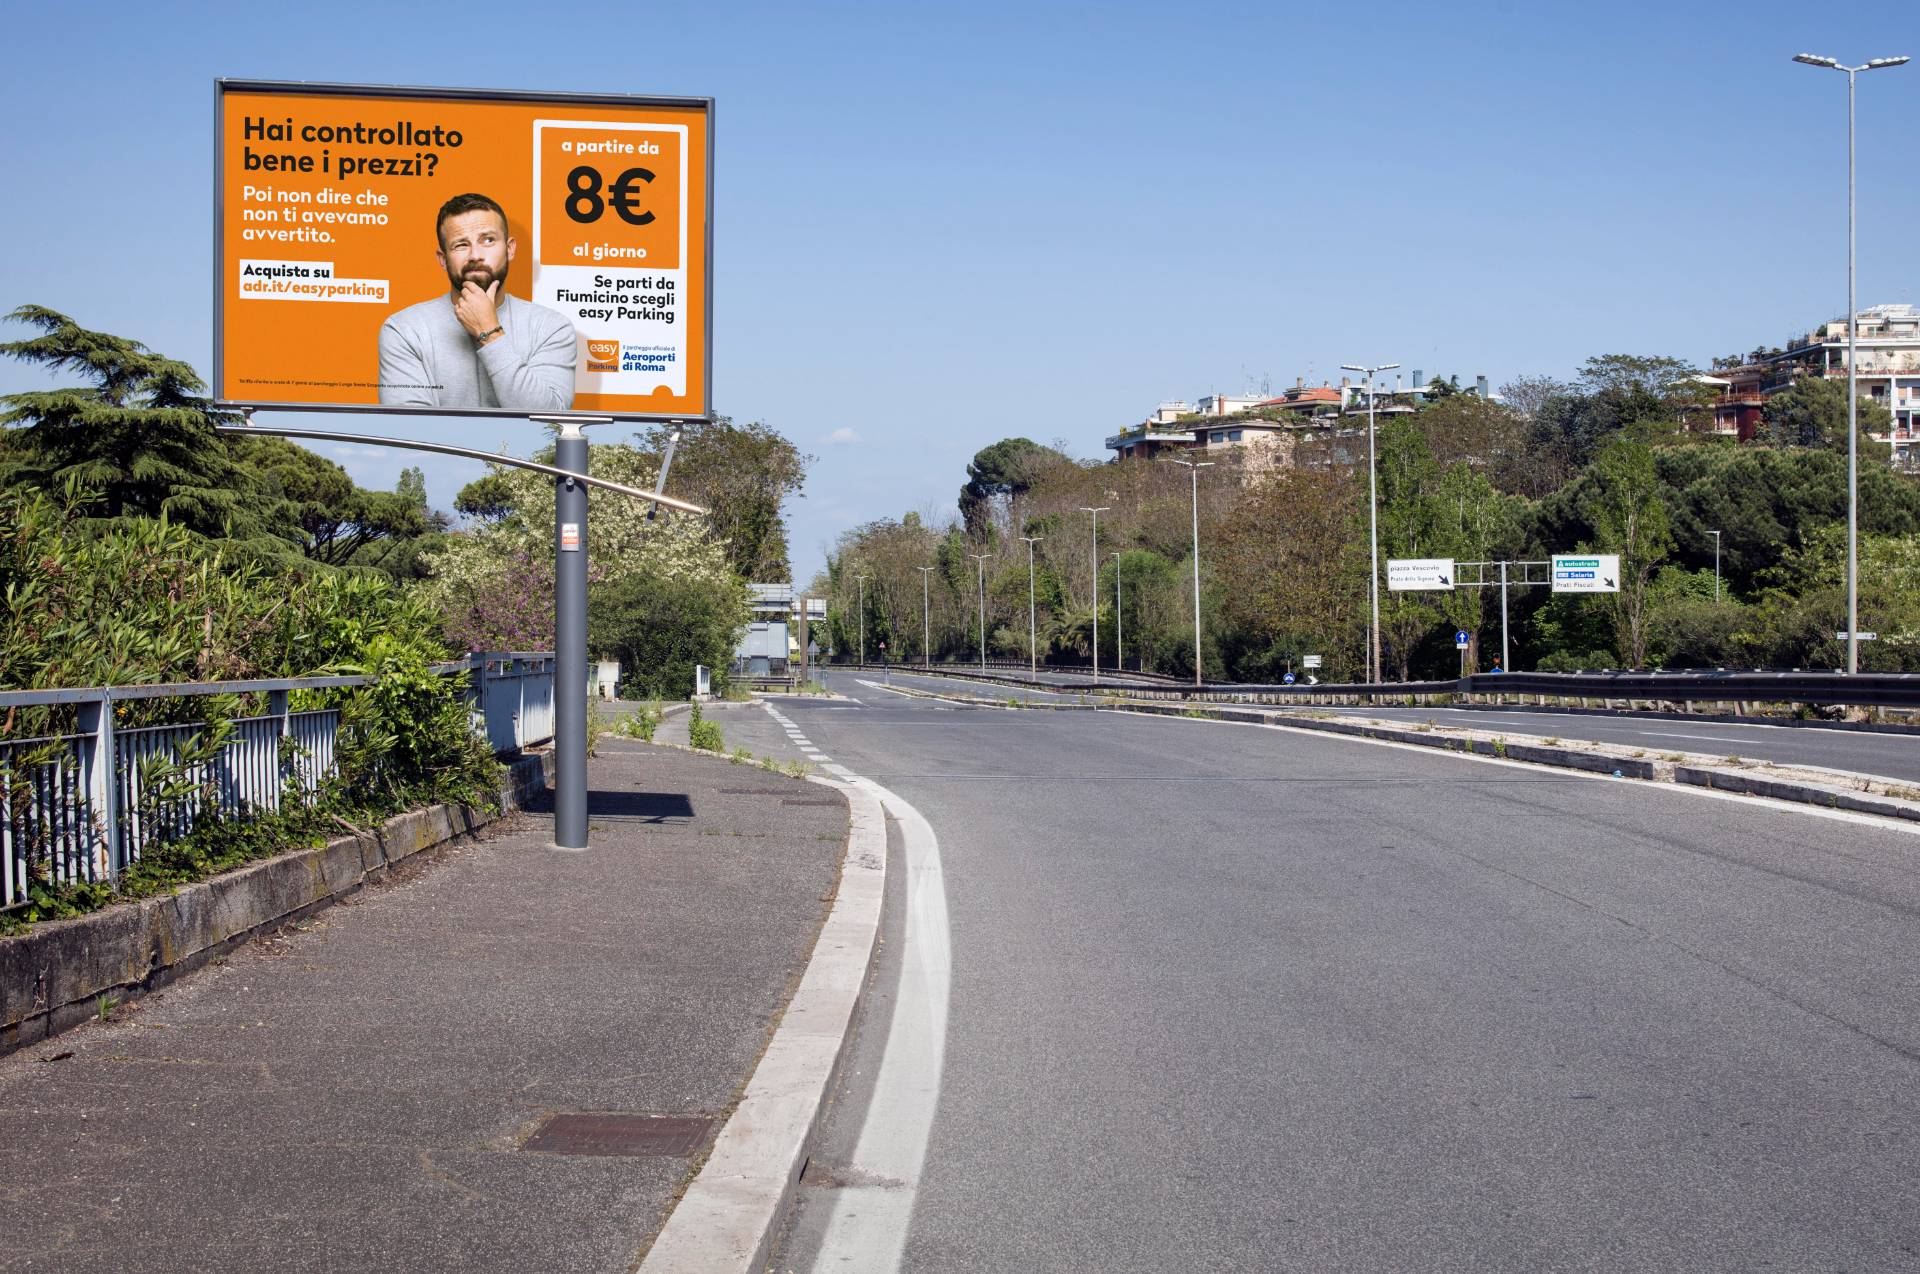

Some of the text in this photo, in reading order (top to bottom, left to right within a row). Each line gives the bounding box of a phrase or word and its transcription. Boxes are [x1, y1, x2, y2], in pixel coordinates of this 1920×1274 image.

[244, 117, 463, 147] Hai controllato
[562, 140, 659, 155] a partire da
[244, 147, 438, 180] bene i prezzi?
[243, 186, 389, 206] Poi non dire che
[565, 166, 656, 225] 8€
[243, 207, 389, 225] non ti avevamo
[242, 226, 336, 243] avvertito.
[573, 242, 647, 260] al giorno
[243, 264, 330, 279] Acquista su
[243, 280, 385, 299] adr.it/easyparking
[594, 275, 675, 291] Se parti da
[557, 289, 675, 308] Fiumicino scegli
[579, 307, 675, 324] easy Parking
[590, 343, 617, 355] easy
[623, 352, 676, 363] Aeroporti
[588, 363, 618, 372] Parking
[622, 362, 666, 371] di Roma
